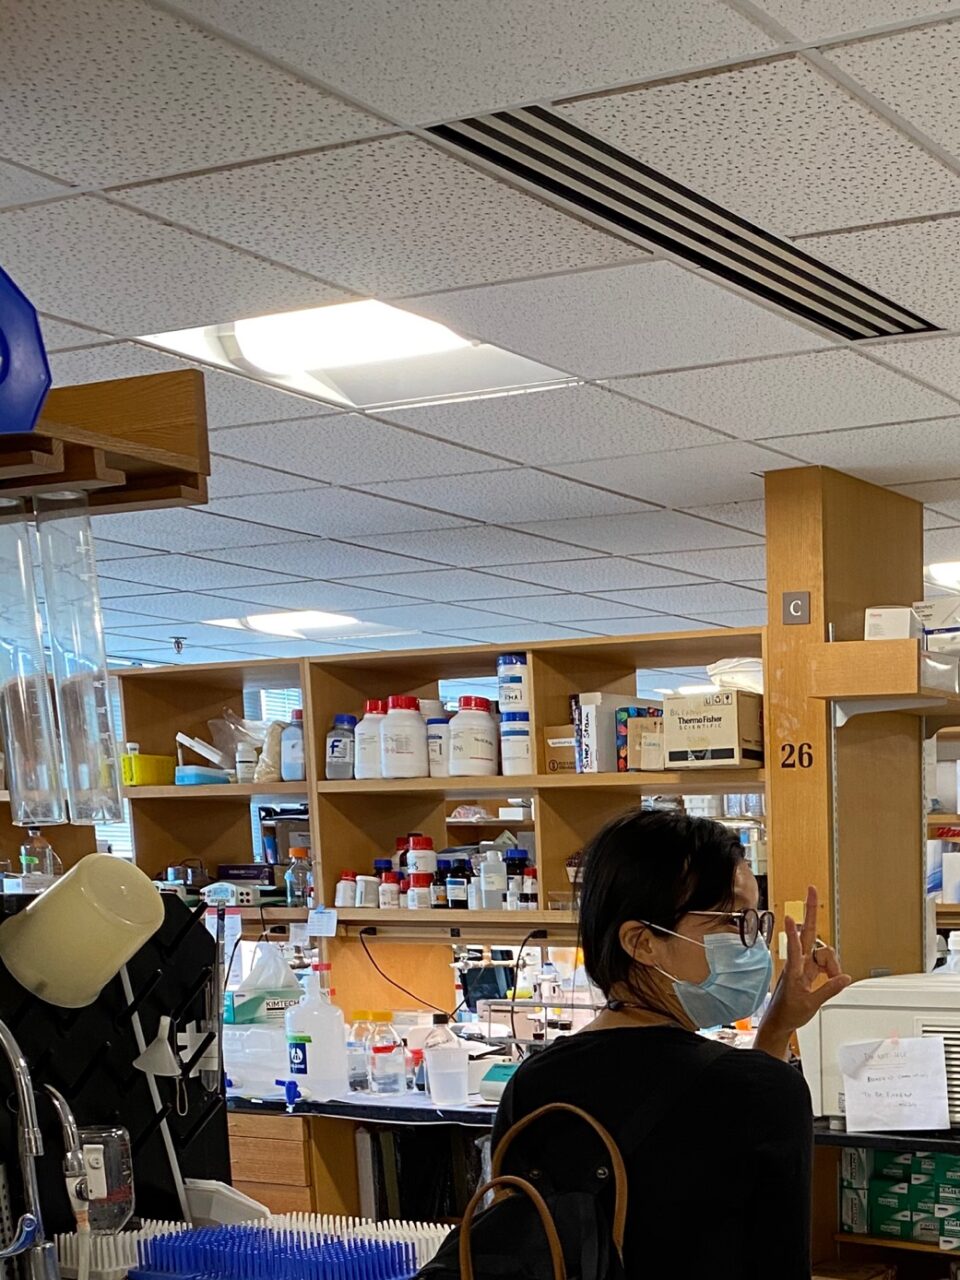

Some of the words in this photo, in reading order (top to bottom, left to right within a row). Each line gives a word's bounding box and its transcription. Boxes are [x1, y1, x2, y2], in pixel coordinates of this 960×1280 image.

[789, 600, 802, 616] C
[582, 743, 590, 770] Silver
[781, 742, 814, 769] 26
